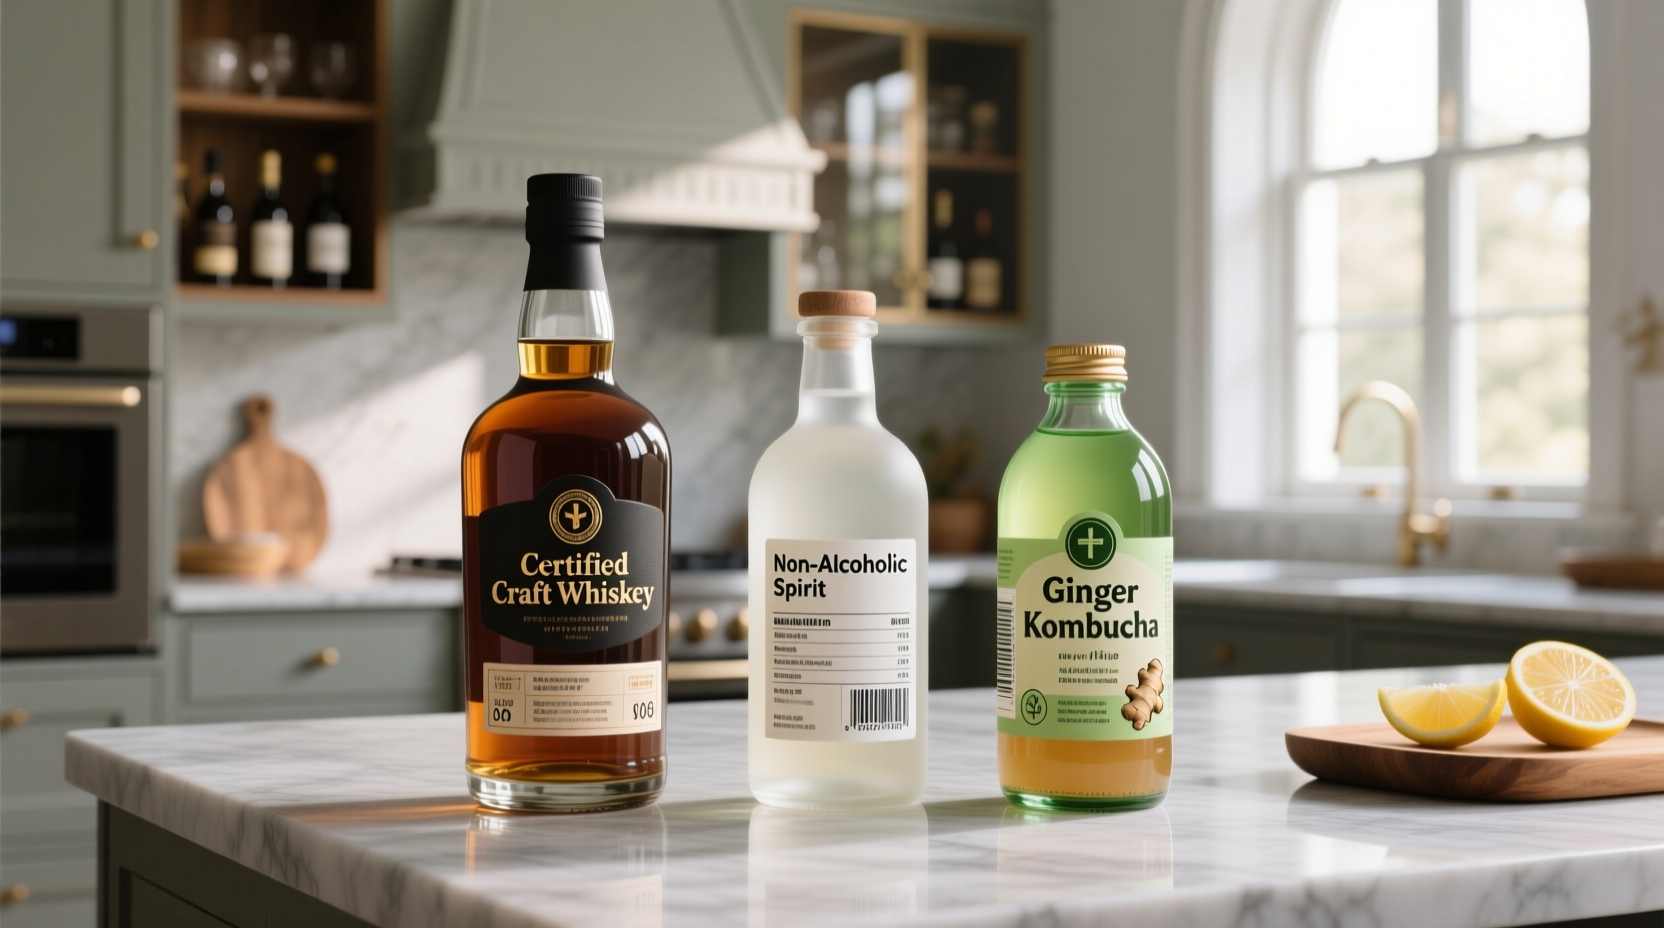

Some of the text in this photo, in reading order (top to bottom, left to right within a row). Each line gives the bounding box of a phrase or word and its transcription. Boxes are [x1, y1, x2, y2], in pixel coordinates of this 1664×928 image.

[521, 551, 629, 577] Certified
[774, 553, 908, 574] Non-Alcoholic
[491, 579, 655, 611] Craft Whiskey
[773, 577, 827, 602] Spirit
[1042, 576, 1139, 613] Ginger
[1024, 610, 1159, 639] Kombucha
